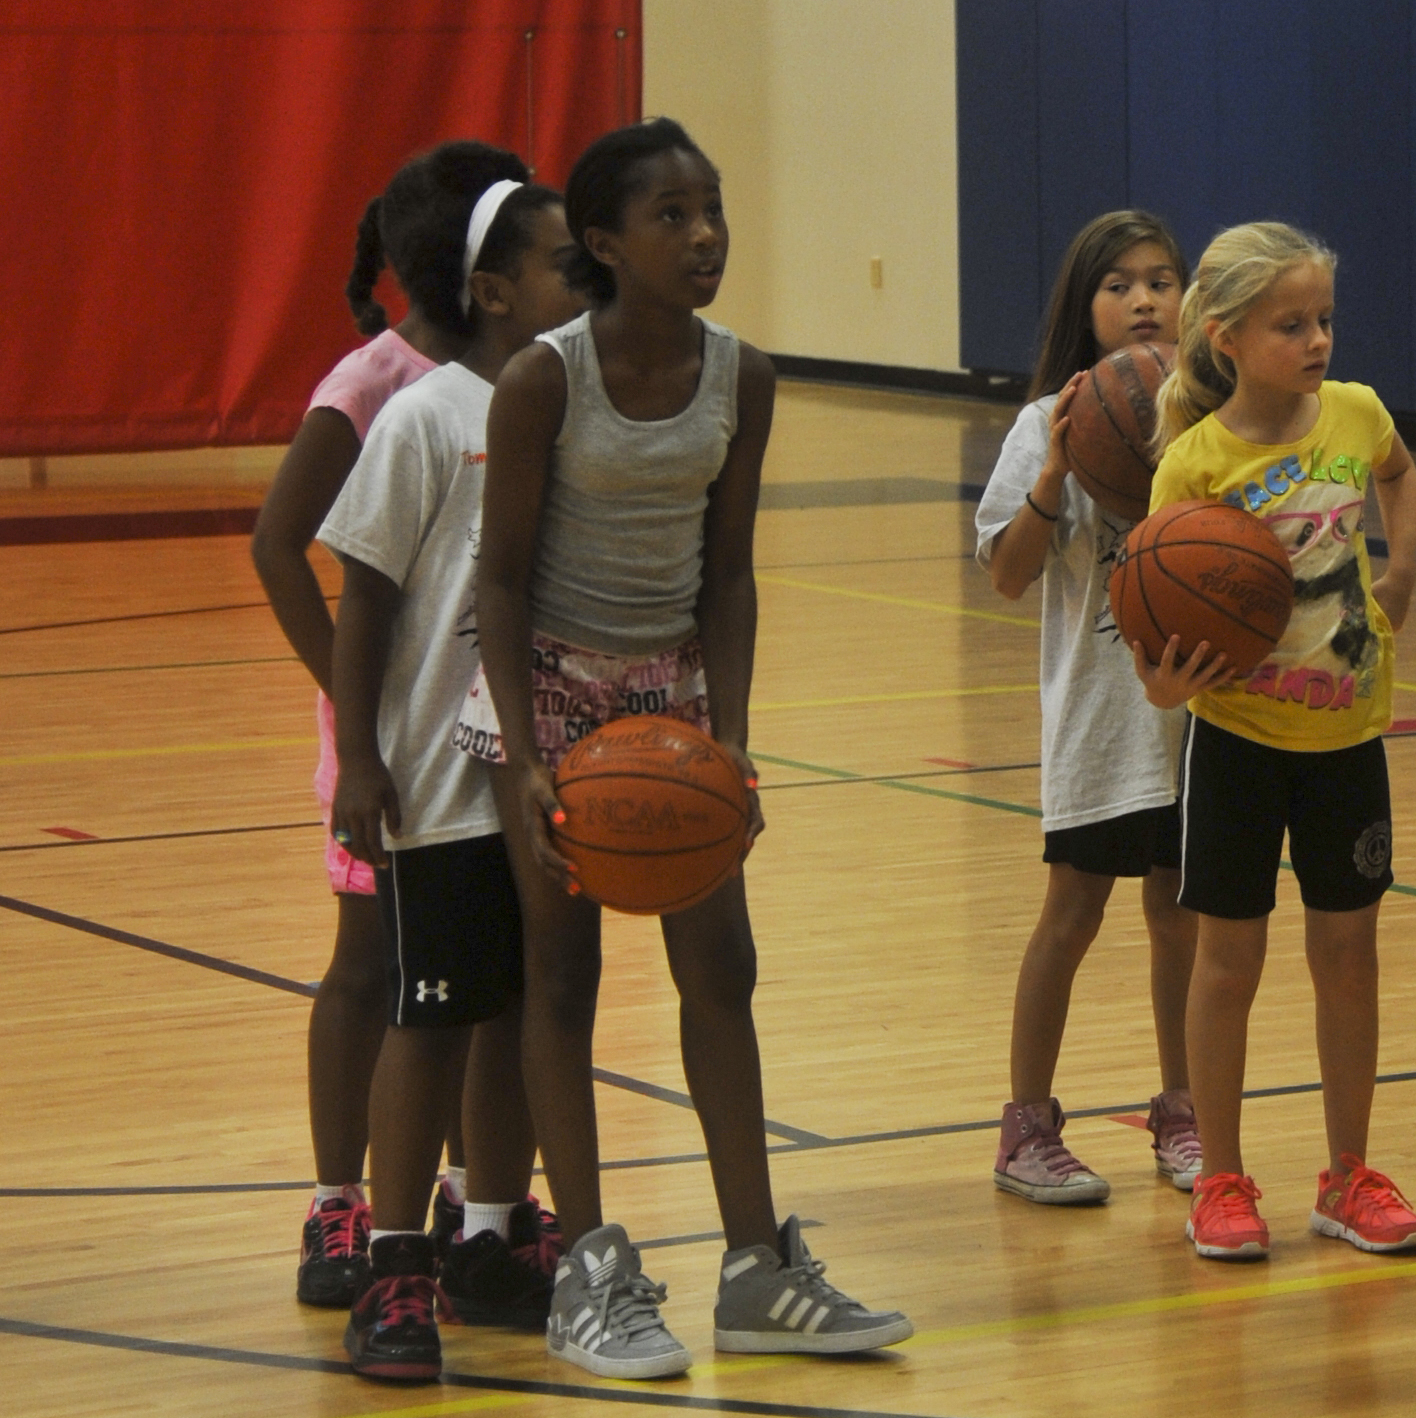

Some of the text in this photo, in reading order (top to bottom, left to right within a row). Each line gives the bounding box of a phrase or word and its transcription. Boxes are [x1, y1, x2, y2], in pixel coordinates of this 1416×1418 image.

[1309, 448, 1368, 491] LOV
[1246, 664, 1354, 711] ANDA
[452, 721, 499, 759] COOL
[584, 796, 682, 830] NCAA
